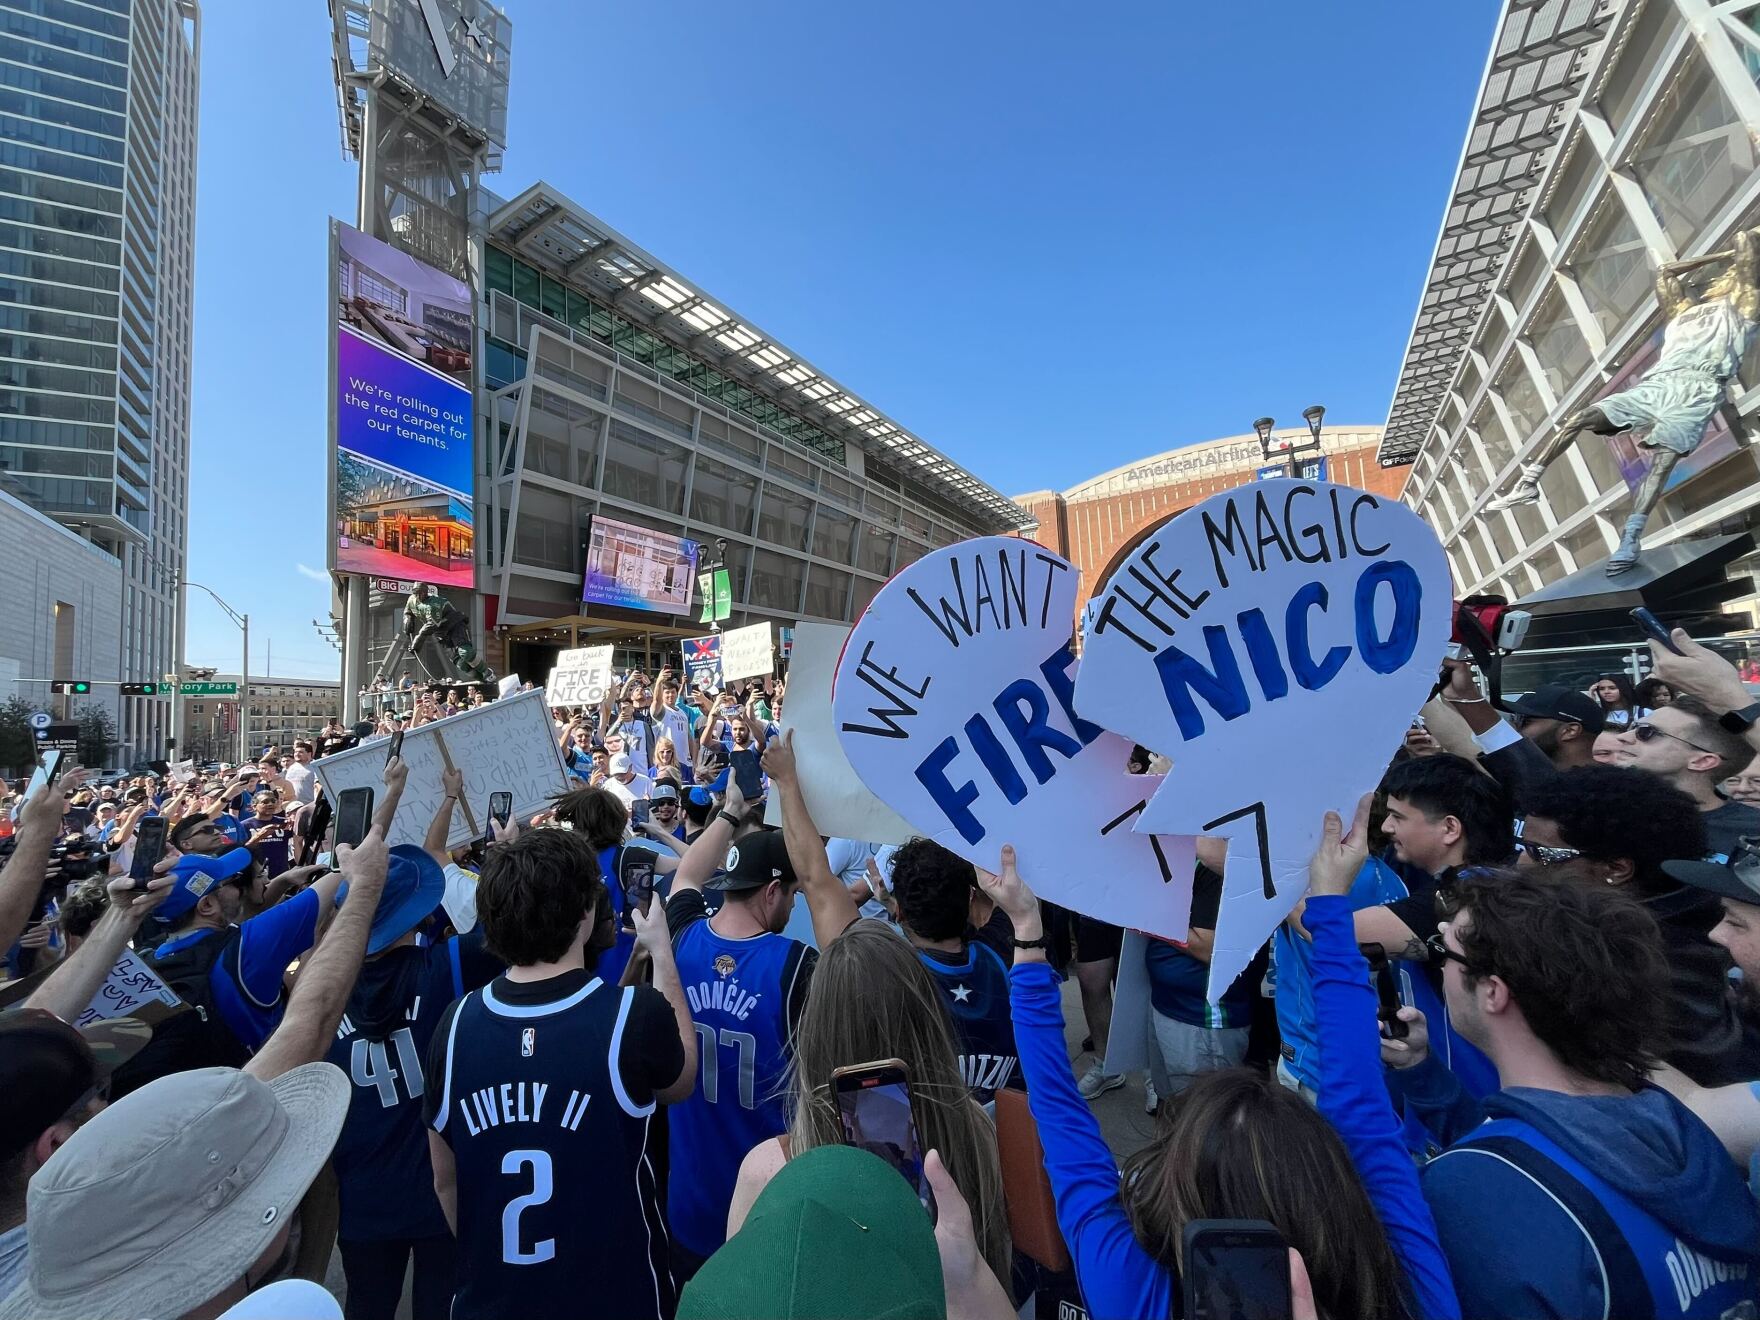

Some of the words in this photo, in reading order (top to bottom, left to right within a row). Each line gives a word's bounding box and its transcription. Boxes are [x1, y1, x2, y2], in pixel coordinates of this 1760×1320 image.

[345, 393, 369, 410] the
[374, 404, 398, 419] red
[402, 413, 445, 434] carpet
[449, 426, 468, 440] for
[349, 377, 392, 400] We're
[396, 395, 438, 417] rolling
[443, 411, 464, 425] out
[367, 419, 391, 432] our
[396, 426, 449, 450] tenants.
[1127, 457, 1204, 481] American
[1205, 445, 1262, 466] Airline
[380, 581, 398, 591] BIG
[1095, 541, 1210, 652] THE
[1201, 487, 1391, 588] MAGIC
[842, 640, 932, 740] WE
[906, 548, 1069, 648] WANT
[1153, 560, 1423, 741] NICO
[163, 683, 202, 691] Vtory
[551, 686, 602, 702] NICO
[555, 669, 601, 687] FIRE
[37, 716, 47, 725] P
[1202, 802, 1278, 899] 7
[687, 977, 761, 1020] DONČIĆ
[351, 1027, 424, 1108] 41
[692, 1021, 756, 1110] 77
[460, 1082, 548, 1137] LIVELY
[560, 1090, 591, 1131] II
[501, 1150, 555, 1265] 2
